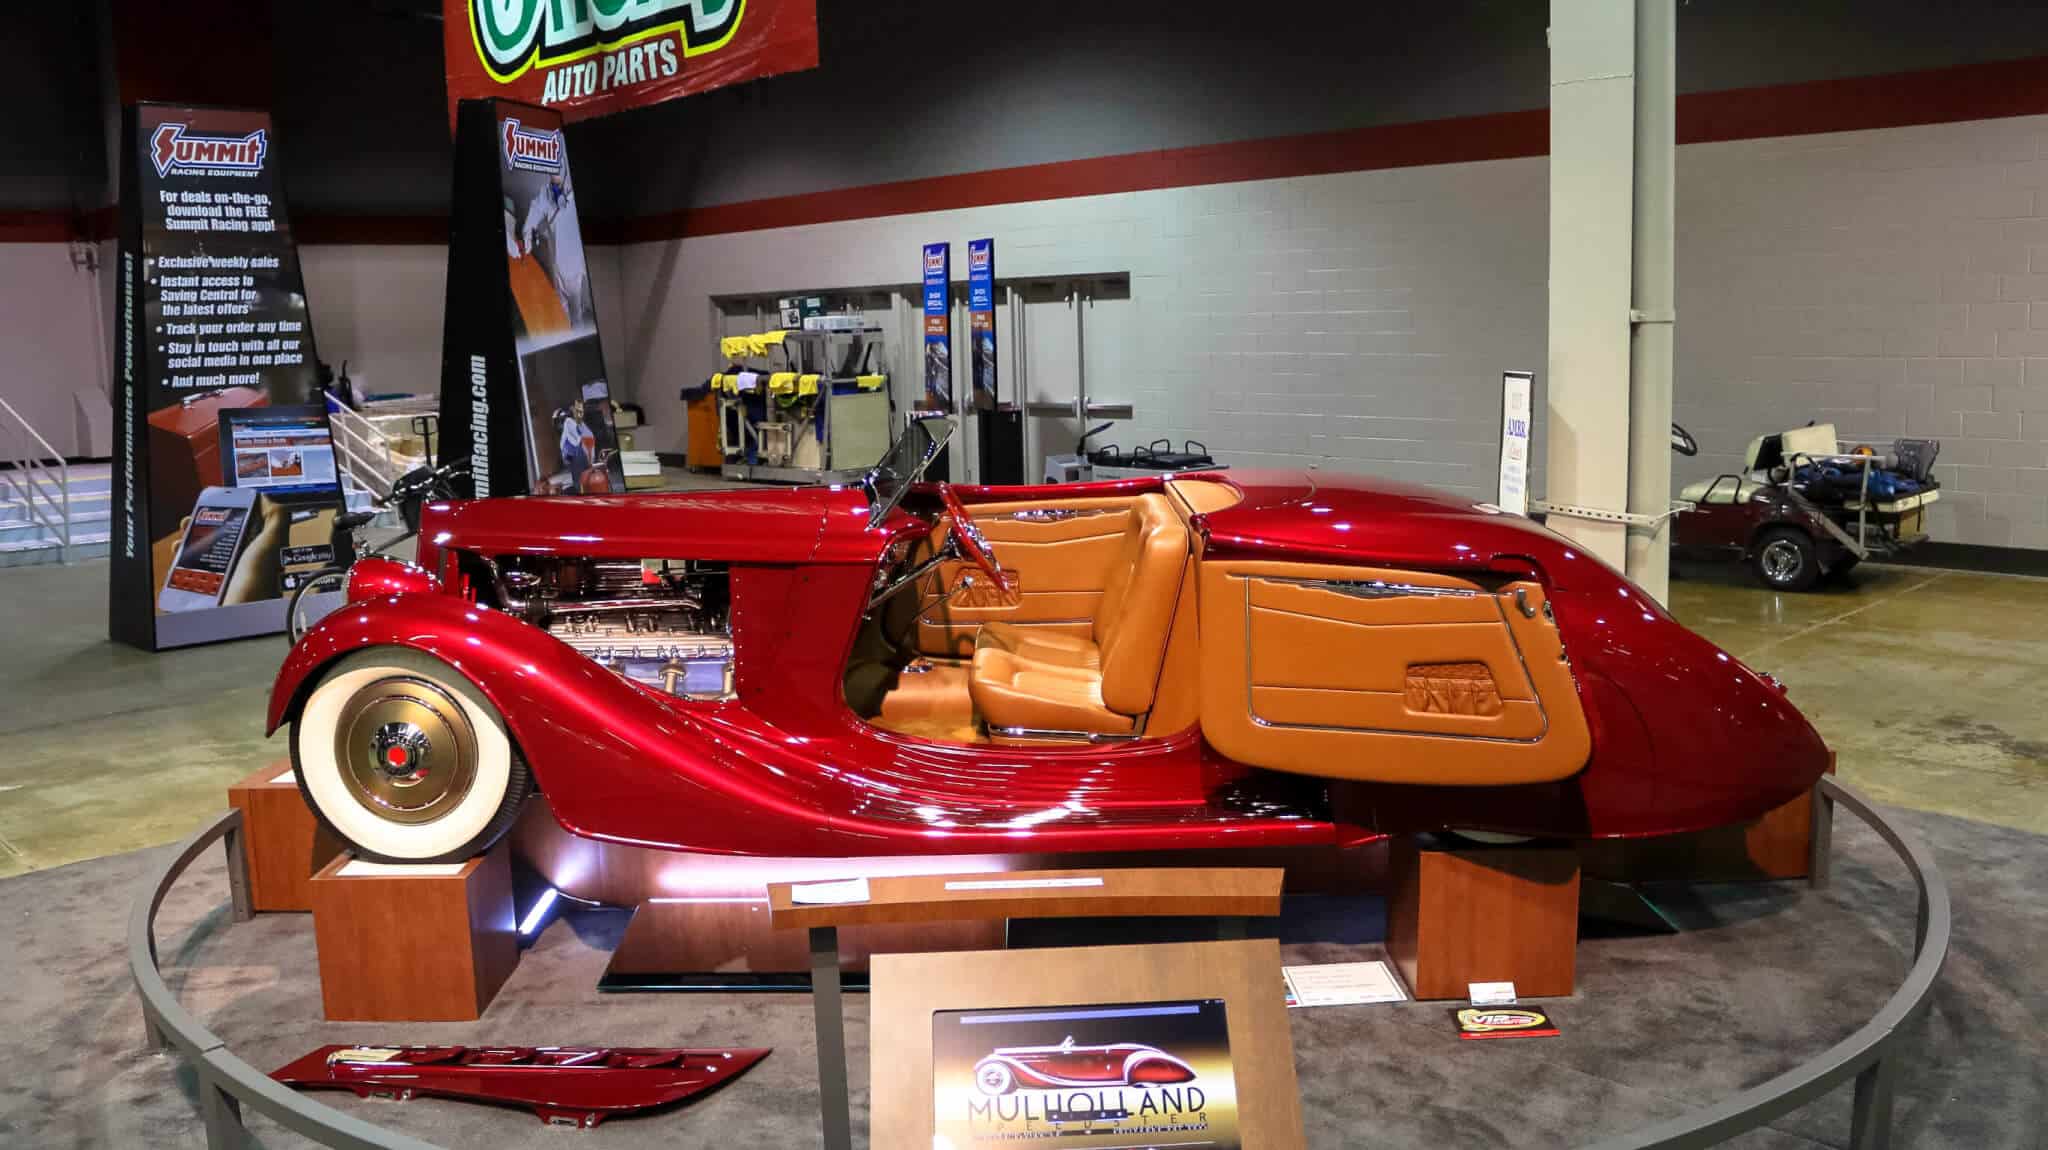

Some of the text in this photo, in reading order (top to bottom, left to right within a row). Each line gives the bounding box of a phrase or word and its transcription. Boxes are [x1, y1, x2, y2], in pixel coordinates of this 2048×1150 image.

[541, 38, 679, 105] AUTO PARTS
[160, 190, 178, 202] For
[181, 191, 211, 203] deals
[167, 204, 268, 217] download the FREE
[165, 217, 275, 232] Summit Racing app!
[158, 256, 279, 269] Exclusive weekly sales
[160, 275, 253, 287] Instant access to
[160, 289, 256, 302] Saving Central for
[162, 303, 249, 316] the latest offers
[166, 320, 302, 335] Track your order any time
[168, 339, 300, 355] Stay in touch with all our
[168, 353, 303, 368] social media in one place
[172, 372, 260, 387] And much more!
[470, 355, 489, 499] mitRacing.com
[968, 1086, 1206, 1122] MULHOLLAND
